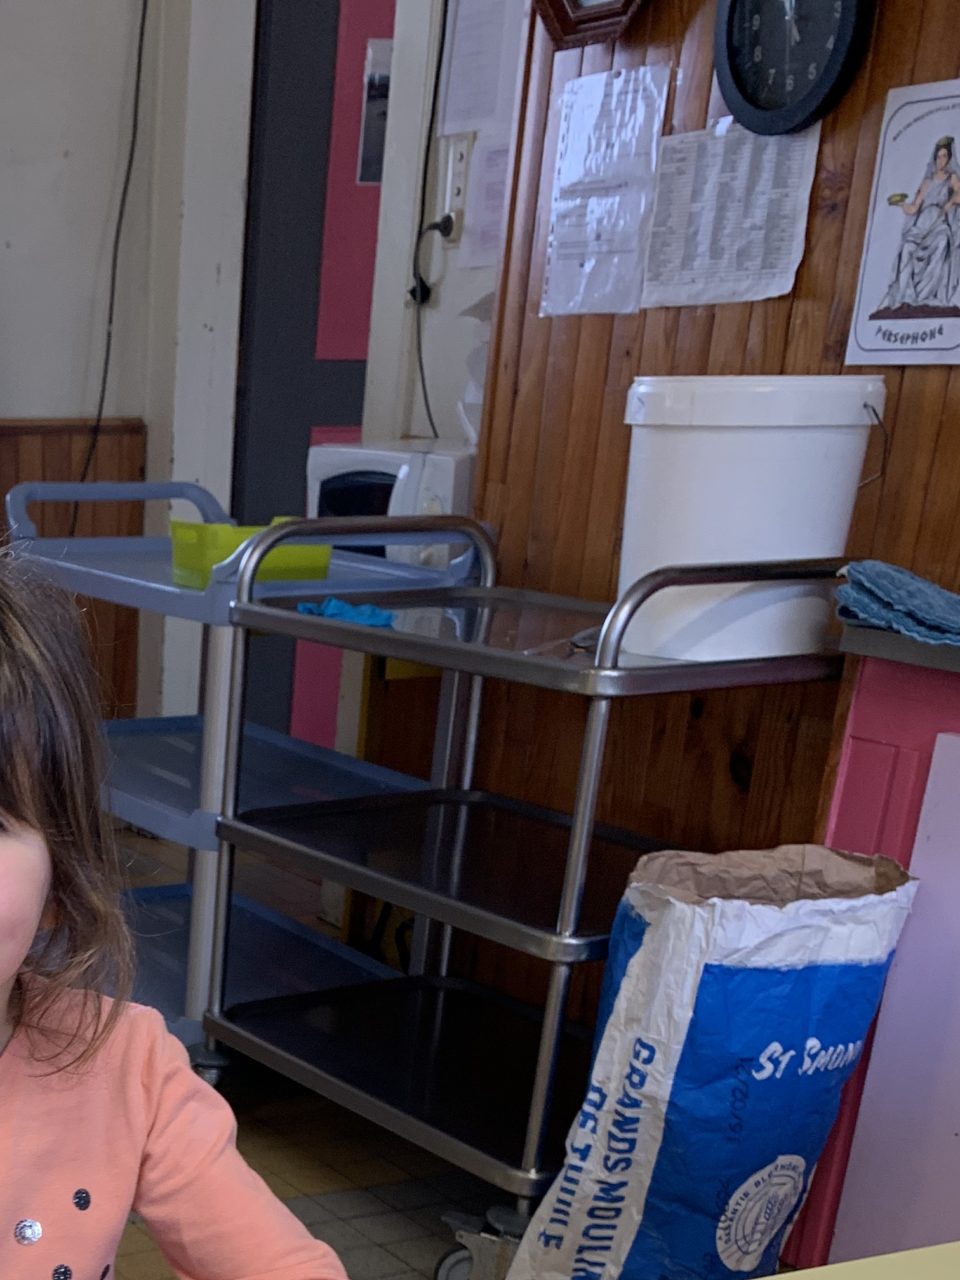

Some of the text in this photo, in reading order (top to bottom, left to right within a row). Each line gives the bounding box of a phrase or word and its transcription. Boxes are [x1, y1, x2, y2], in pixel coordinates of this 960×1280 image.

[767, 68, 777, 85] 7
[808, 62, 818, 80] 5
[785, 75, 795, 92] 6
[602, 1037, 657, 1173] GRANDS
